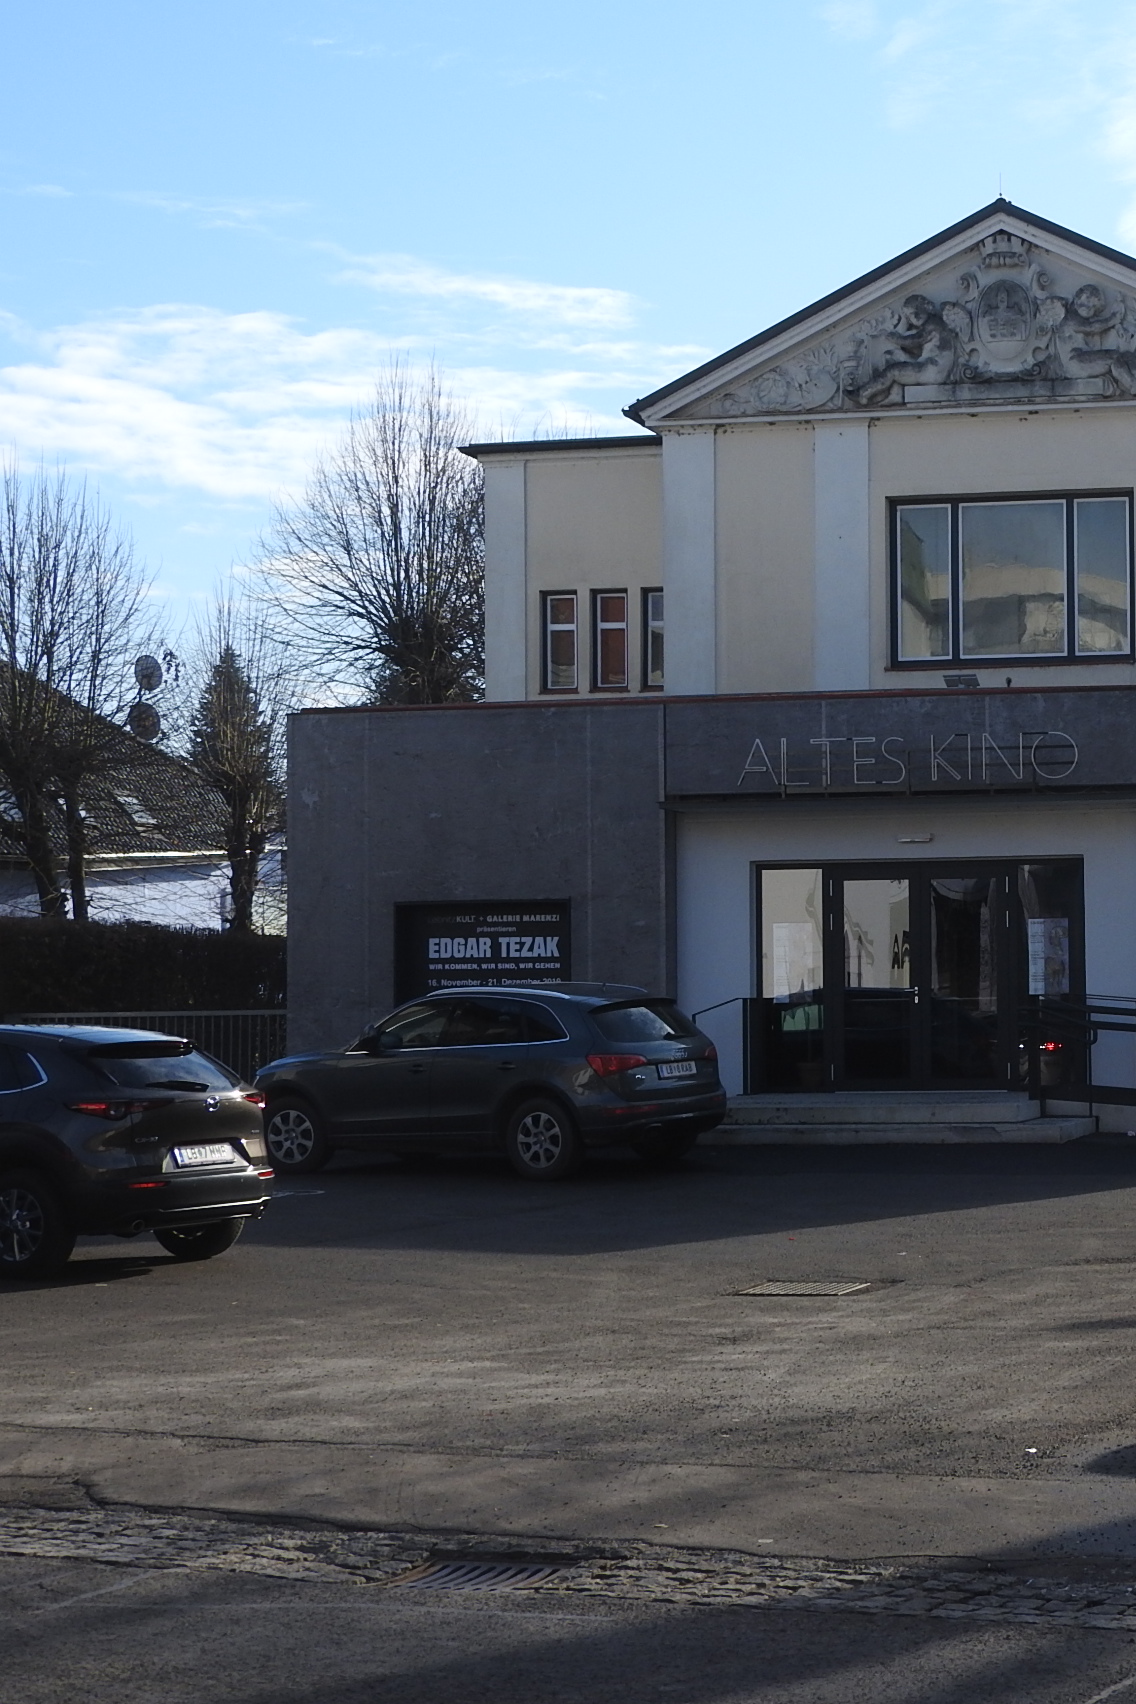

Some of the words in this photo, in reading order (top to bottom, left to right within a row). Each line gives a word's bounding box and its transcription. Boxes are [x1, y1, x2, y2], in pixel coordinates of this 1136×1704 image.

[737, 738, 906, 785] ALTES
[931, 732, 1078, 780] KINO
[487, 915, 520, 923] GALERIE
[429, 938, 491, 958] EDGAR
[499, 937, 559, 957] TEZAK
[441, 979, 480, 987] November
[488, 979, 499, 987] 21.
